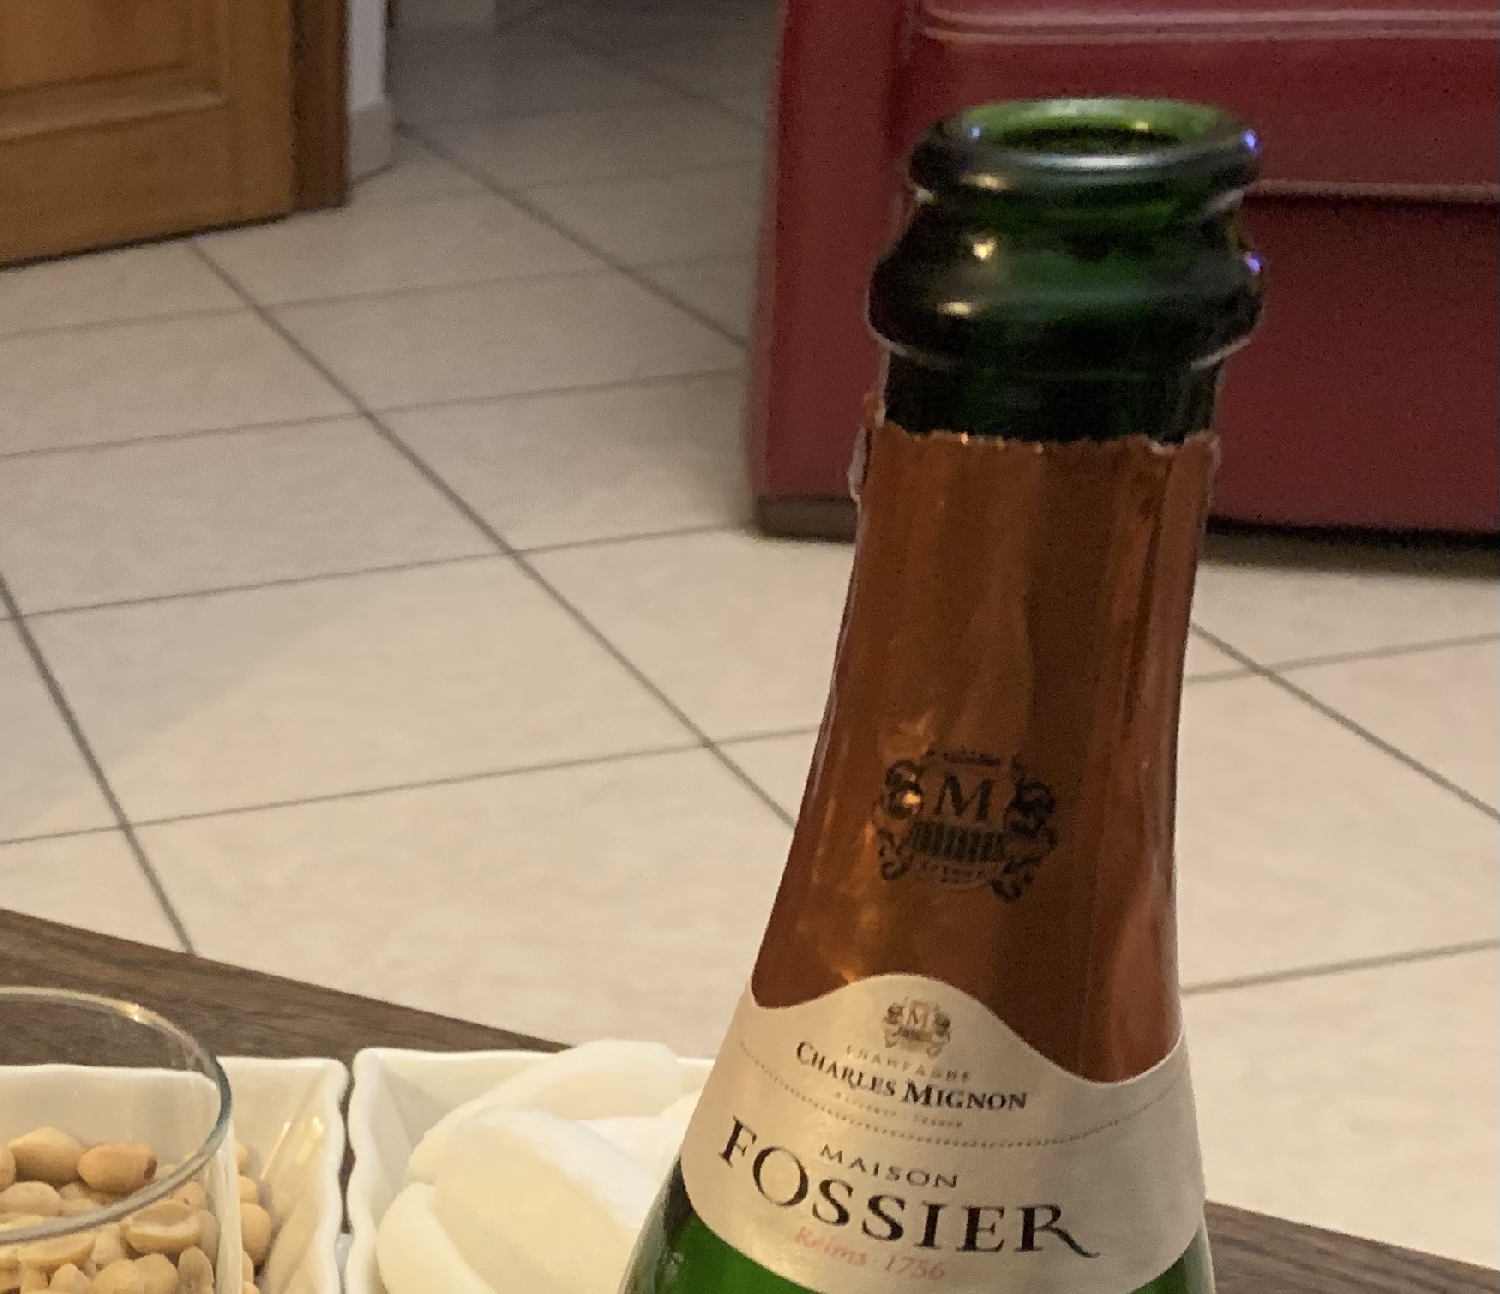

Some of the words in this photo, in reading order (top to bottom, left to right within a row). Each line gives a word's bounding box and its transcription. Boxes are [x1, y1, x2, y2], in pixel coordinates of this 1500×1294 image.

[796, 1041, 896, 1097] CHARLES
[902, 1079, 1028, 1112] MIGNON
[718, 1114, 1100, 1259] FOSSIER
[819, 1143, 959, 1189] MAISON
[794, 1225, 868, 1266] Reims
